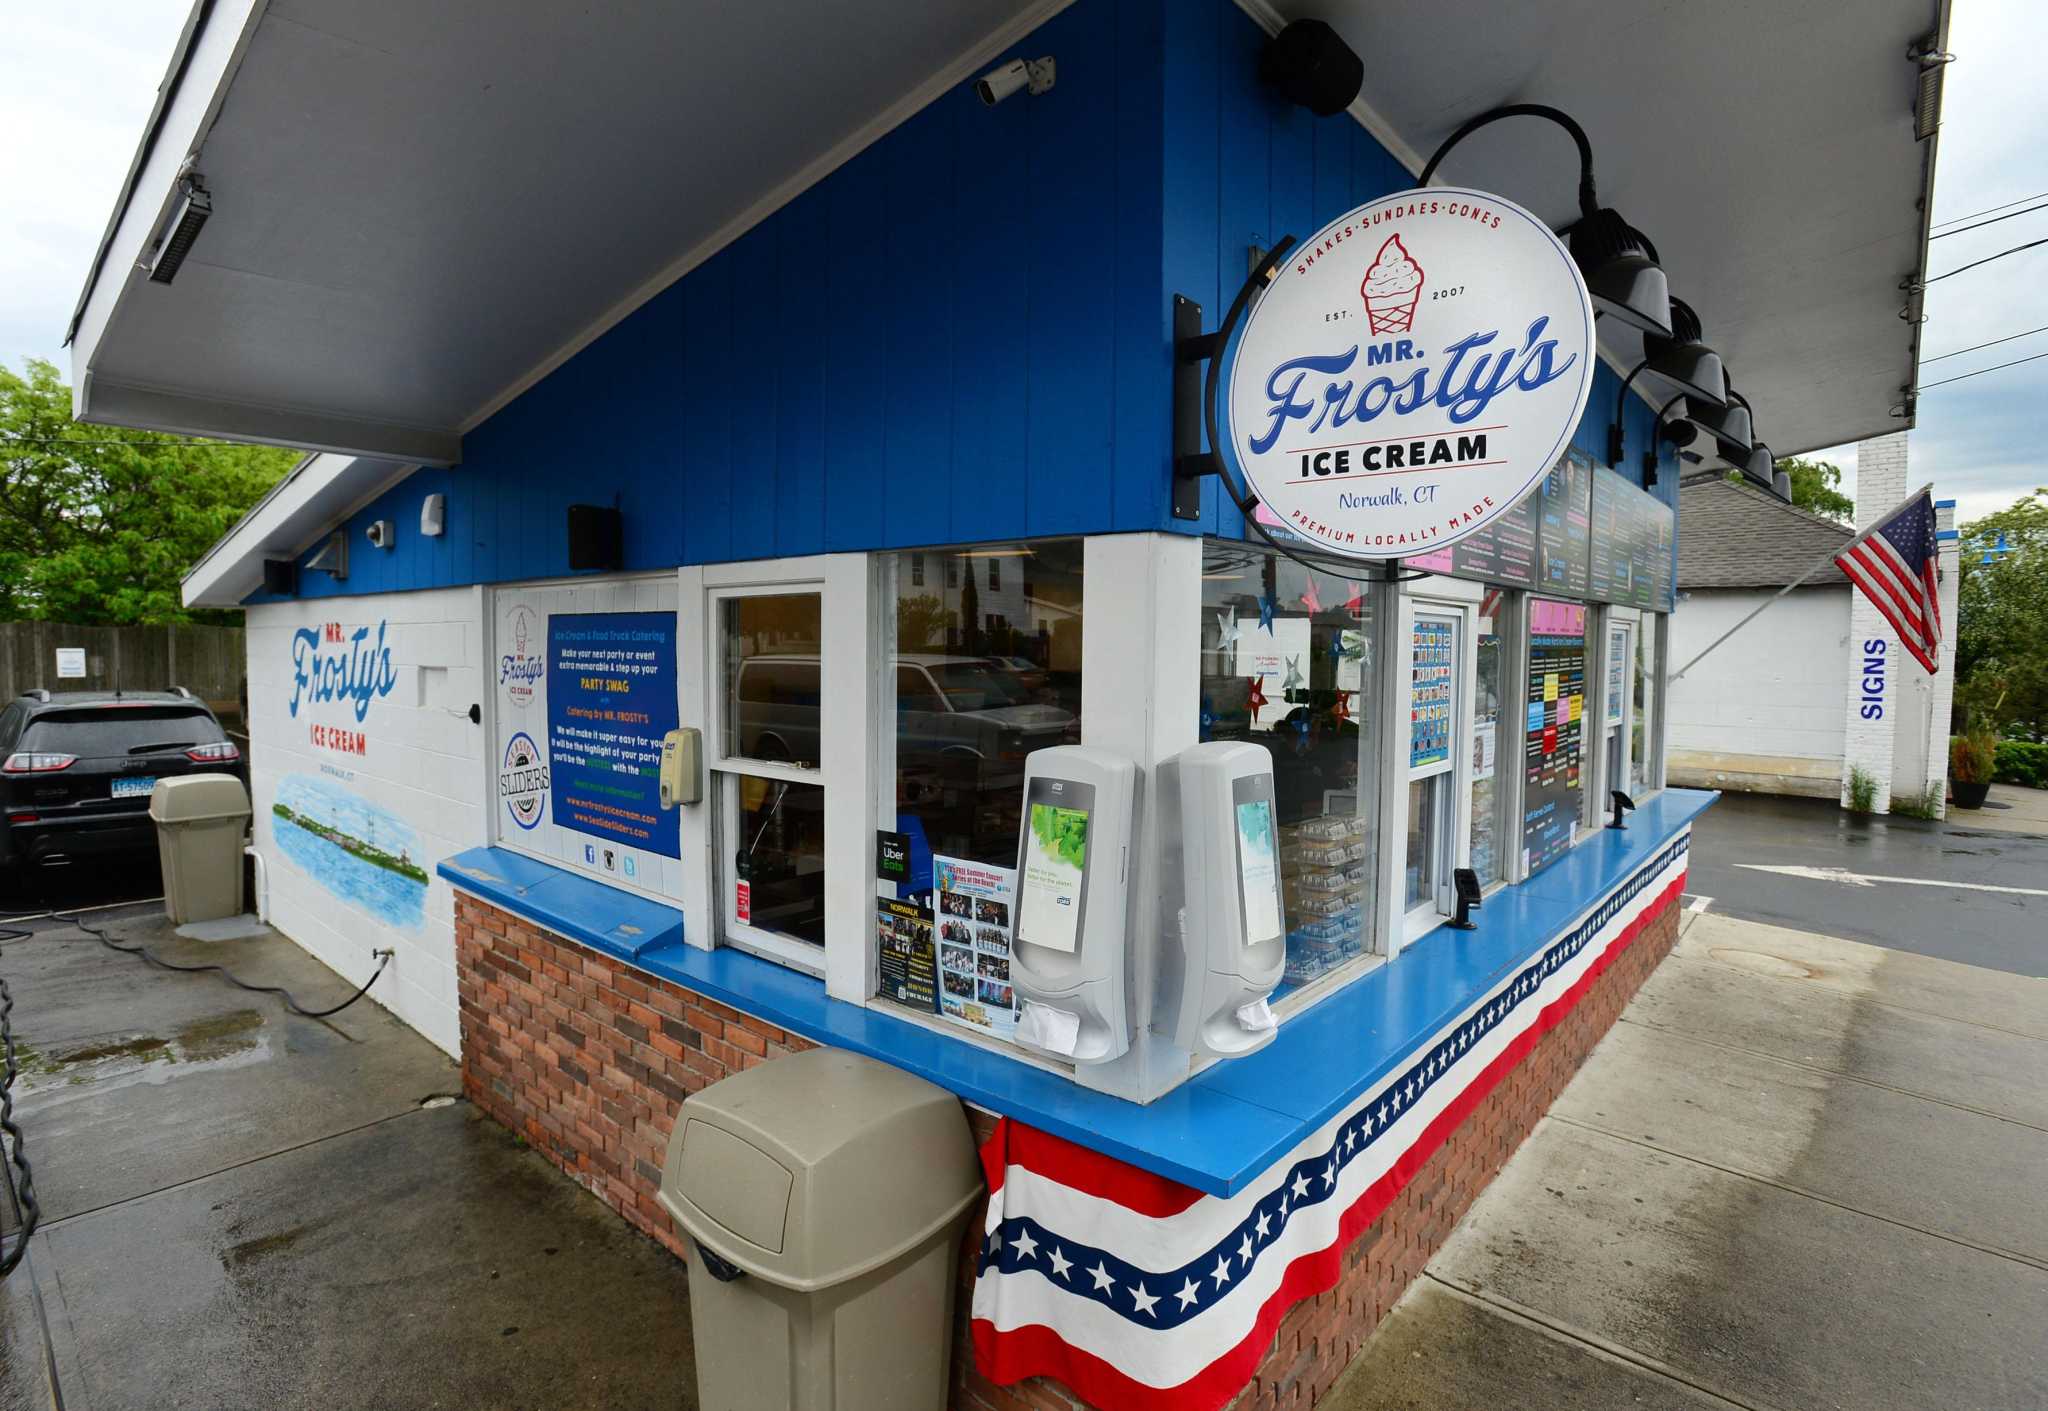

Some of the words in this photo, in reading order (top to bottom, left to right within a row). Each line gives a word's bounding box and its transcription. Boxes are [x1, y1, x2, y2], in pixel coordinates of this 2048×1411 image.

[1297, 226, 1354, 275] SHAKES
[1362, 201, 1438, 229] SUNDAES
[1449, 202, 1501, 230] CONES
[1325, 310, 1354, 322] EST.
[1432, 286, 1465, 300] 2007
[1367, 339, 1424, 366] MR.
[1248, 315, 1577, 455] Frosty's
[1301, 450, 1350, 478] ICE
[1362, 434, 1488, 472] CREAM
[1339, 489, 1408, 511] Norwalk,
[1413, 485, 1440, 504] CT
[1291, 509, 1355, 545] PREMIUM
[1364, 526, 1438, 545] LOCALLY
[1450, 494, 1494, 530] MADE
[325, 622, 345, 643] MR.
[631, 630, 666, 643] Catering
[559, 661, 575, 670] extra
[575, 662, 609, 672] memorable
[615, 663, 630, 674] step
[631, 665, 640, 675] up
[641, 665, 659, 675] your
[561, 648, 577, 658] Make
[577, 649, 591, 660] your
[591, 649, 606, 658] next
[606, 650, 626, 662] party
[626, 652, 634, 660] or
[635, 651, 655, 661] event
[289, 619, 398, 723] Frosty's
[500, 654, 544, 685] Frosty's
[1860, 639, 1887, 720] SIGNS
[580, 677, 604, 690] PARTY
[605, 678, 630, 693] SWAG
[566, 705, 593, 720] Catering
[593, 708, 603, 720] by
[310, 724, 325, 746] ICE
[328, 727, 366, 756] CREAM
[565, 727, 576, 736] will
[576, 728, 592, 738] make
[593, 729, 598, 740] it
[599, 731, 617, 743] super
[618, 734, 636, 747] easy
[637, 735, 648, 746] for
[574, 741, 584, 751] the
[584, 743, 612, 758] highlight
[612, 748, 620, 758] of
[621, 750, 637, 761] your
[639, 752, 660, 765] party
[575, 756, 586, 766] the
[611, 761, 627, 773] with
[628, 764, 640, 776] the
[500, 766, 550, 796] SLIDERS
[883, 847, 904, 860] Uber
[890, 902, 919, 917] NORWALK
